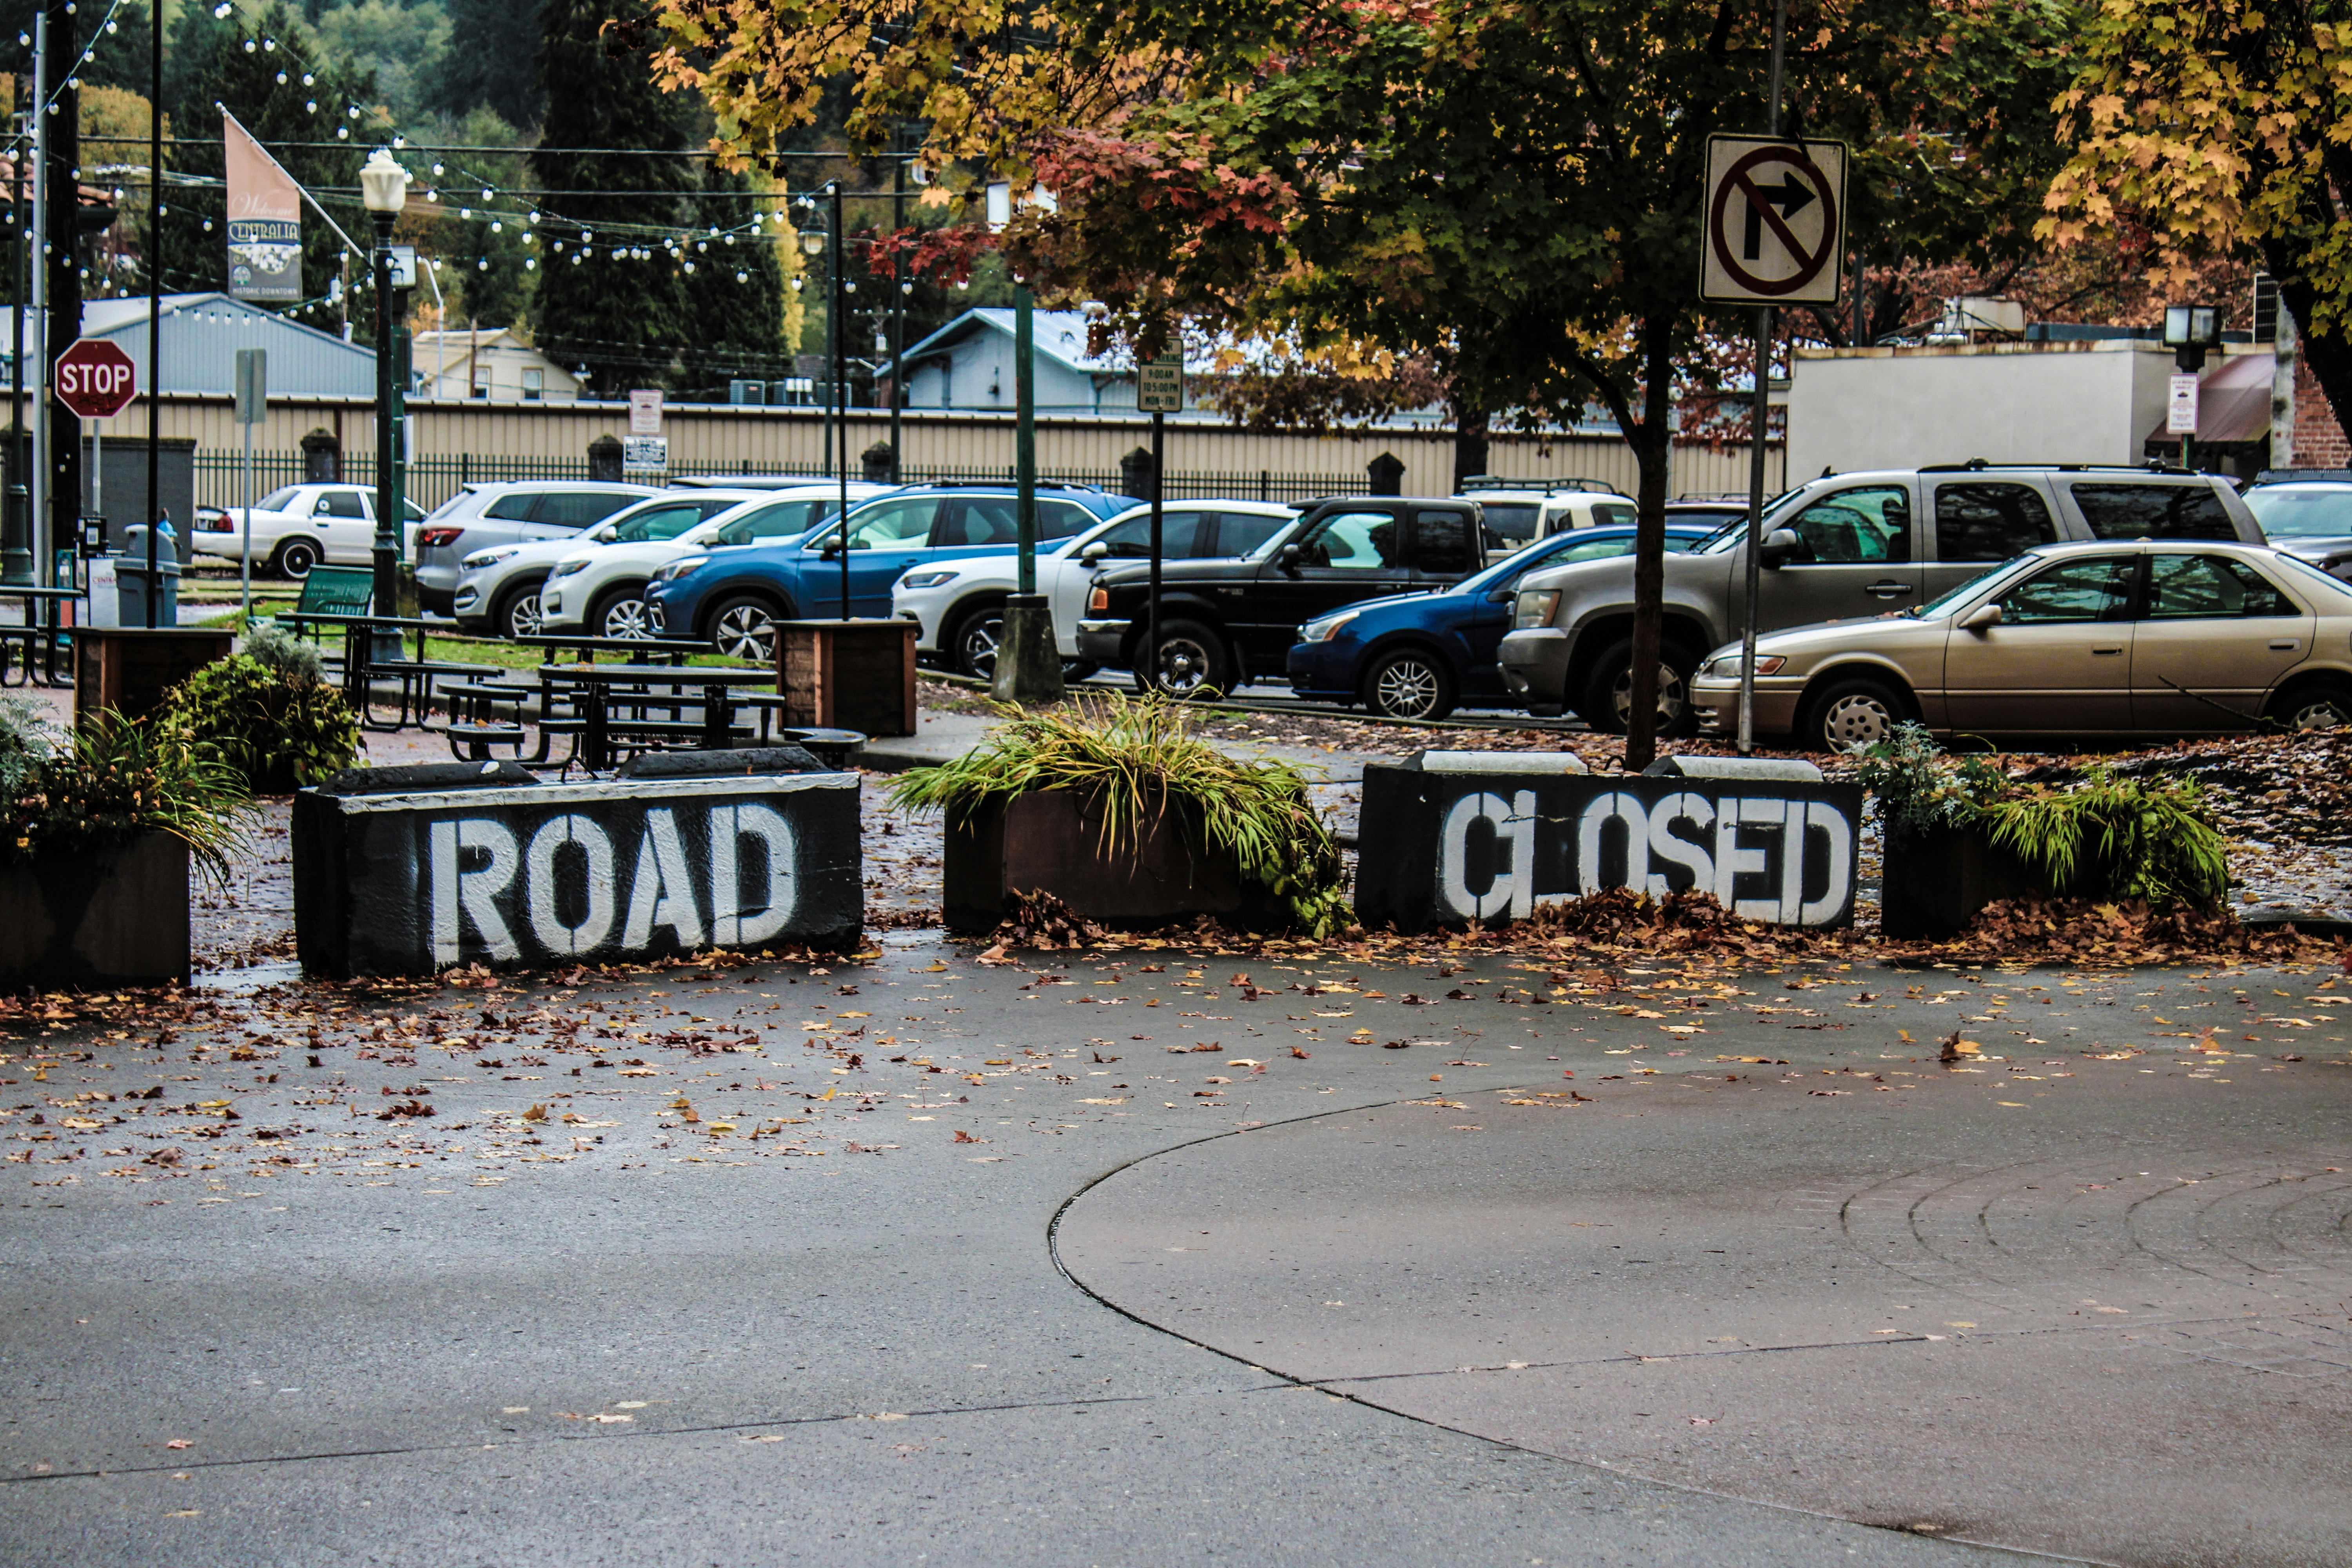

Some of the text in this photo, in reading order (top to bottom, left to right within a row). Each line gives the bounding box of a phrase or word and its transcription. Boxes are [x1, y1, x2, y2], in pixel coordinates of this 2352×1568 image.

[229, 222, 299, 243] CENTRALIA
[62, 363, 130, 394] STOP
[430, 802, 796, 966] ROAD
[1443, 789, 1851, 926] CLOSED
